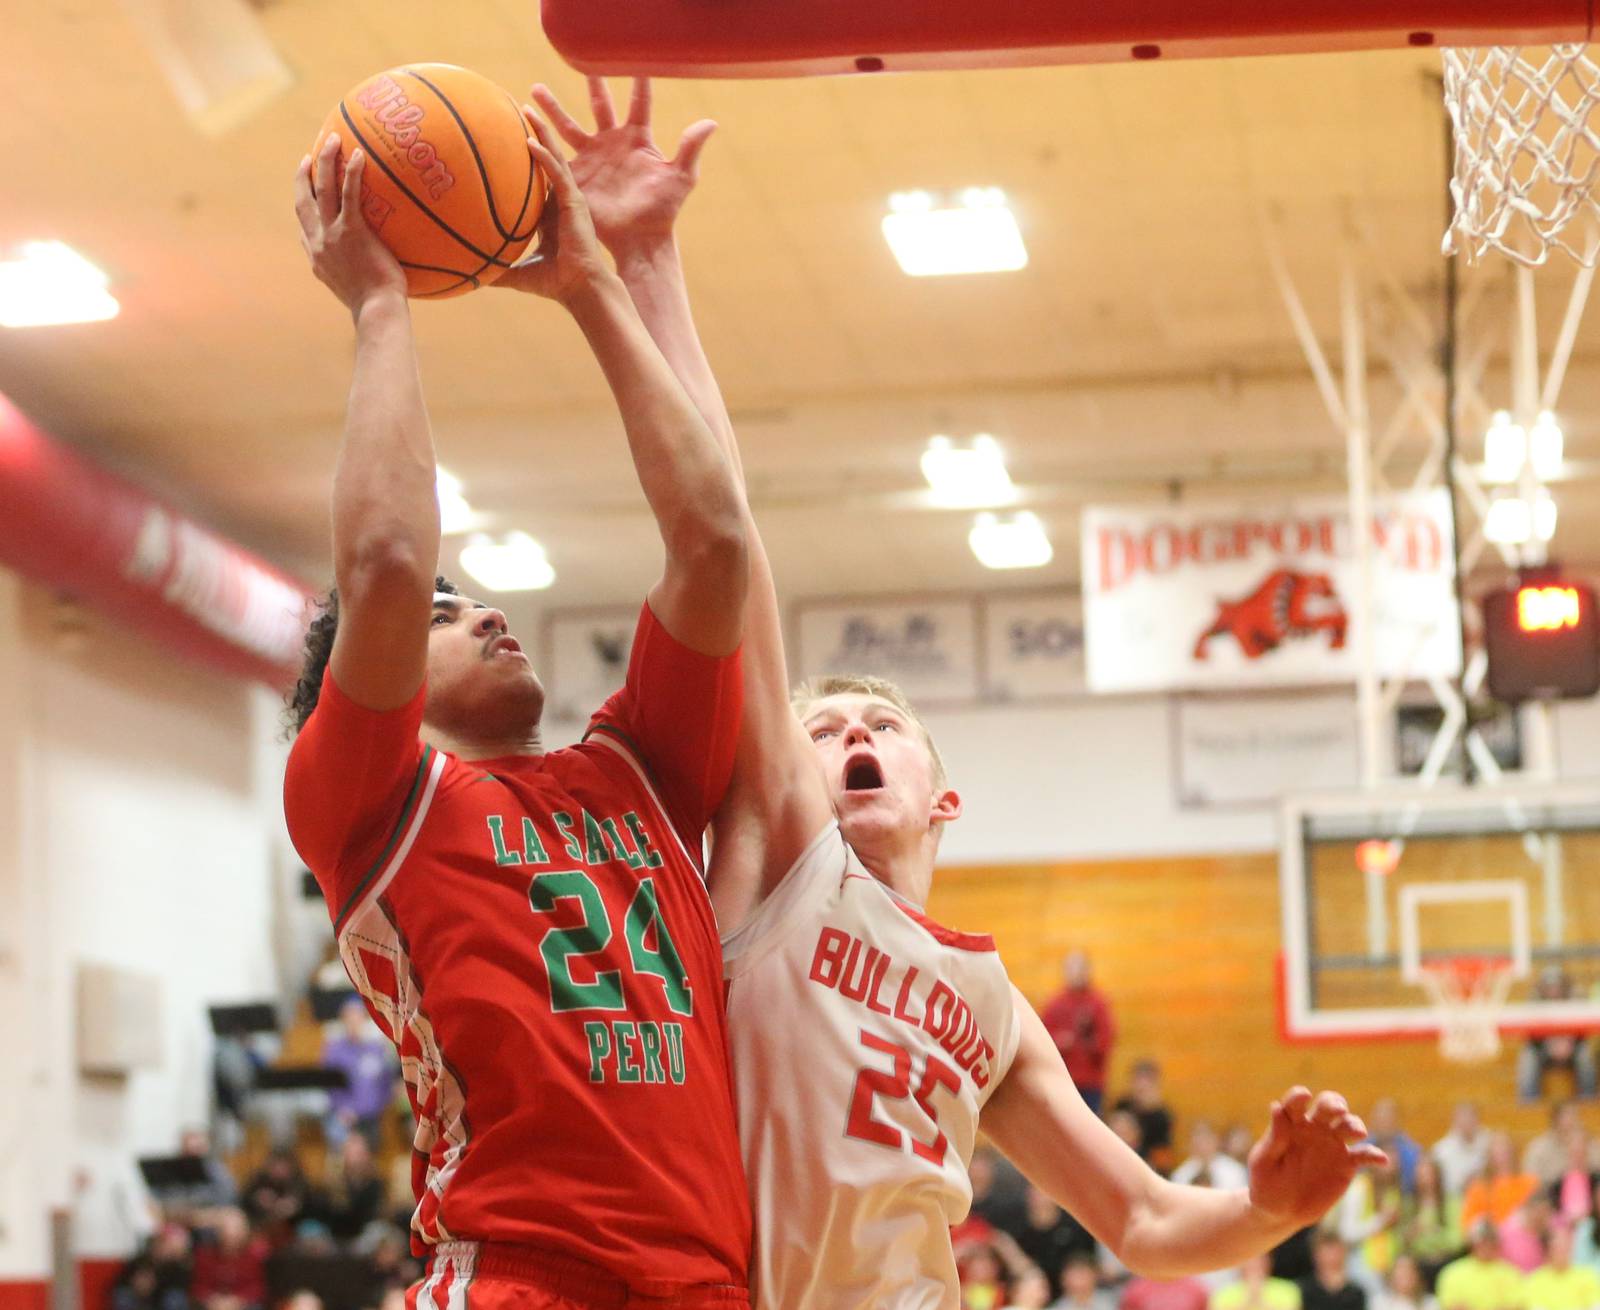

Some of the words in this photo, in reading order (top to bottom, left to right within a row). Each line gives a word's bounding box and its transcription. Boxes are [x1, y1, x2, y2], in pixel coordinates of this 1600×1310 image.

[356, 75, 455, 202] Wilson
[486, 814, 551, 866] LA
[551, 807, 665, 870] SALE
[527, 870, 694, 1017] 24
[808, 925, 995, 1090] BULLDOGS
[583, 1020, 686, 1085] PERU
[844, 1028, 962, 1168] 25
